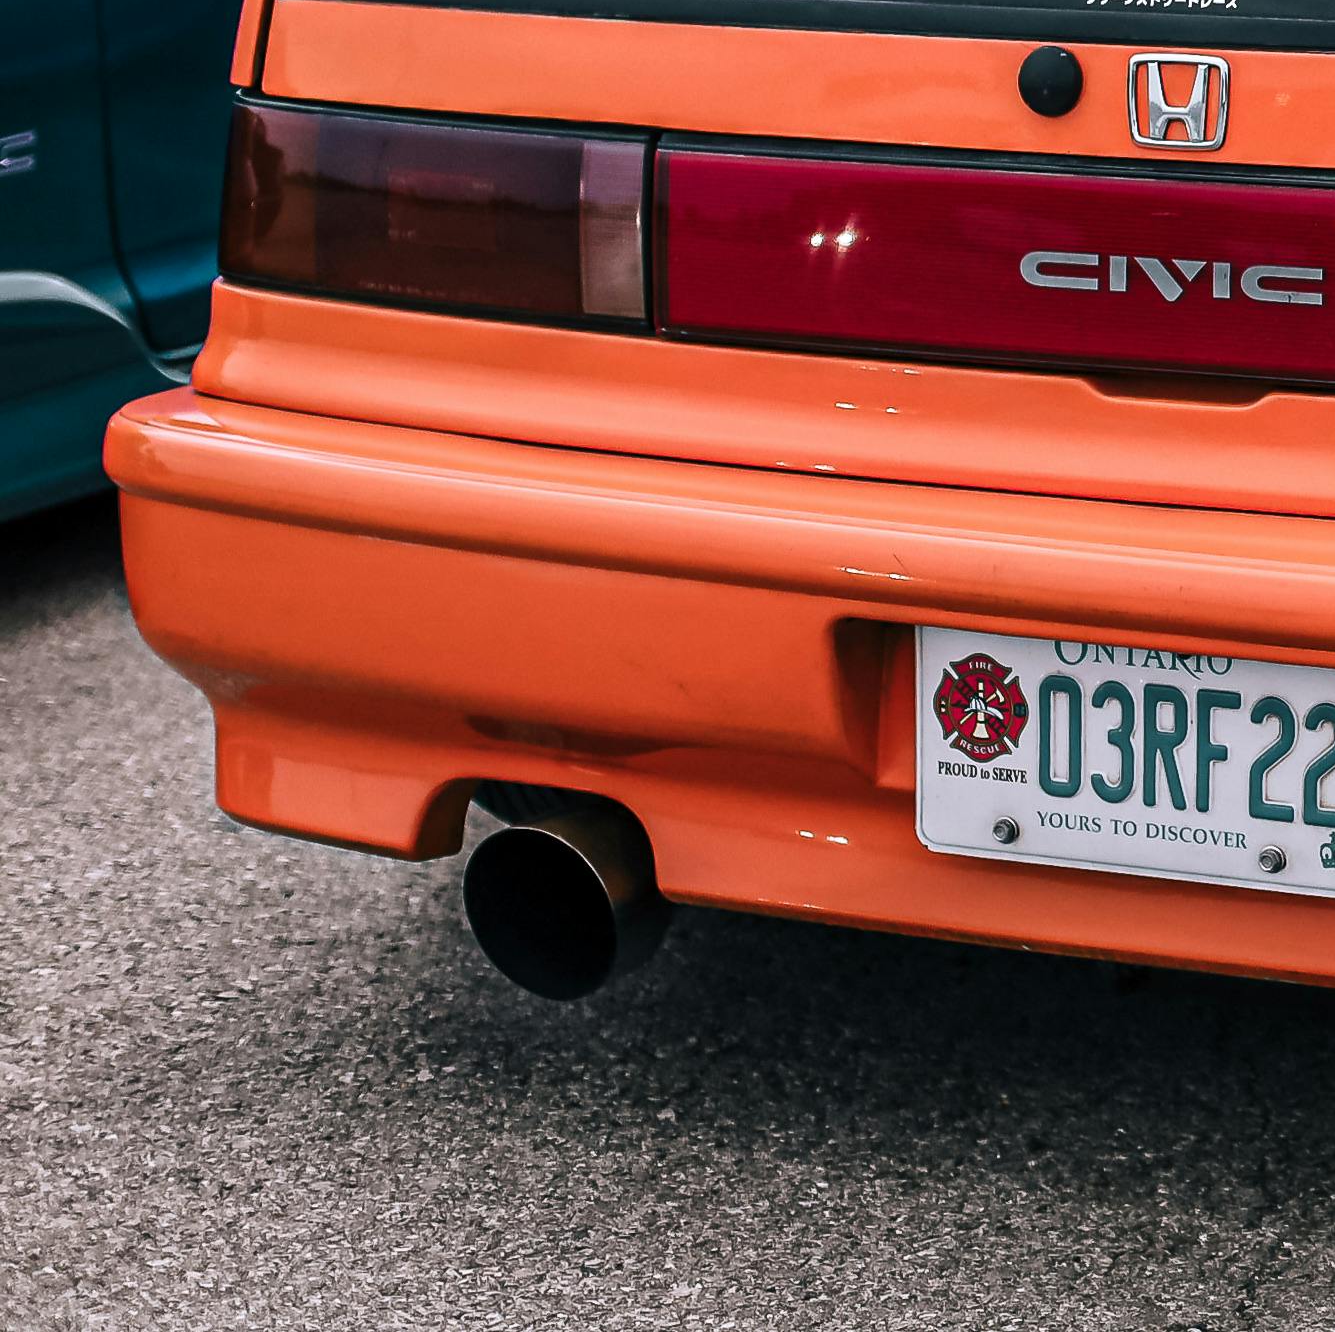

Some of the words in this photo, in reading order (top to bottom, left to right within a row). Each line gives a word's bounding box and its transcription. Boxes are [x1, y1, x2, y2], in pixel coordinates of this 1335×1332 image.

[1020, 251, 1323, 305] CIVIC
[968, 661, 992, 671] FIRE
[938, 760, 977, 778] PROUD
[980, 767, 990, 780] to
[992, 767, 1028, 784] SERVE
[1037, 811, 1101, 833] YOURS
[1110, 819, 1137, 836] TO
[1146, 823, 1248, 850] DISCOVER
